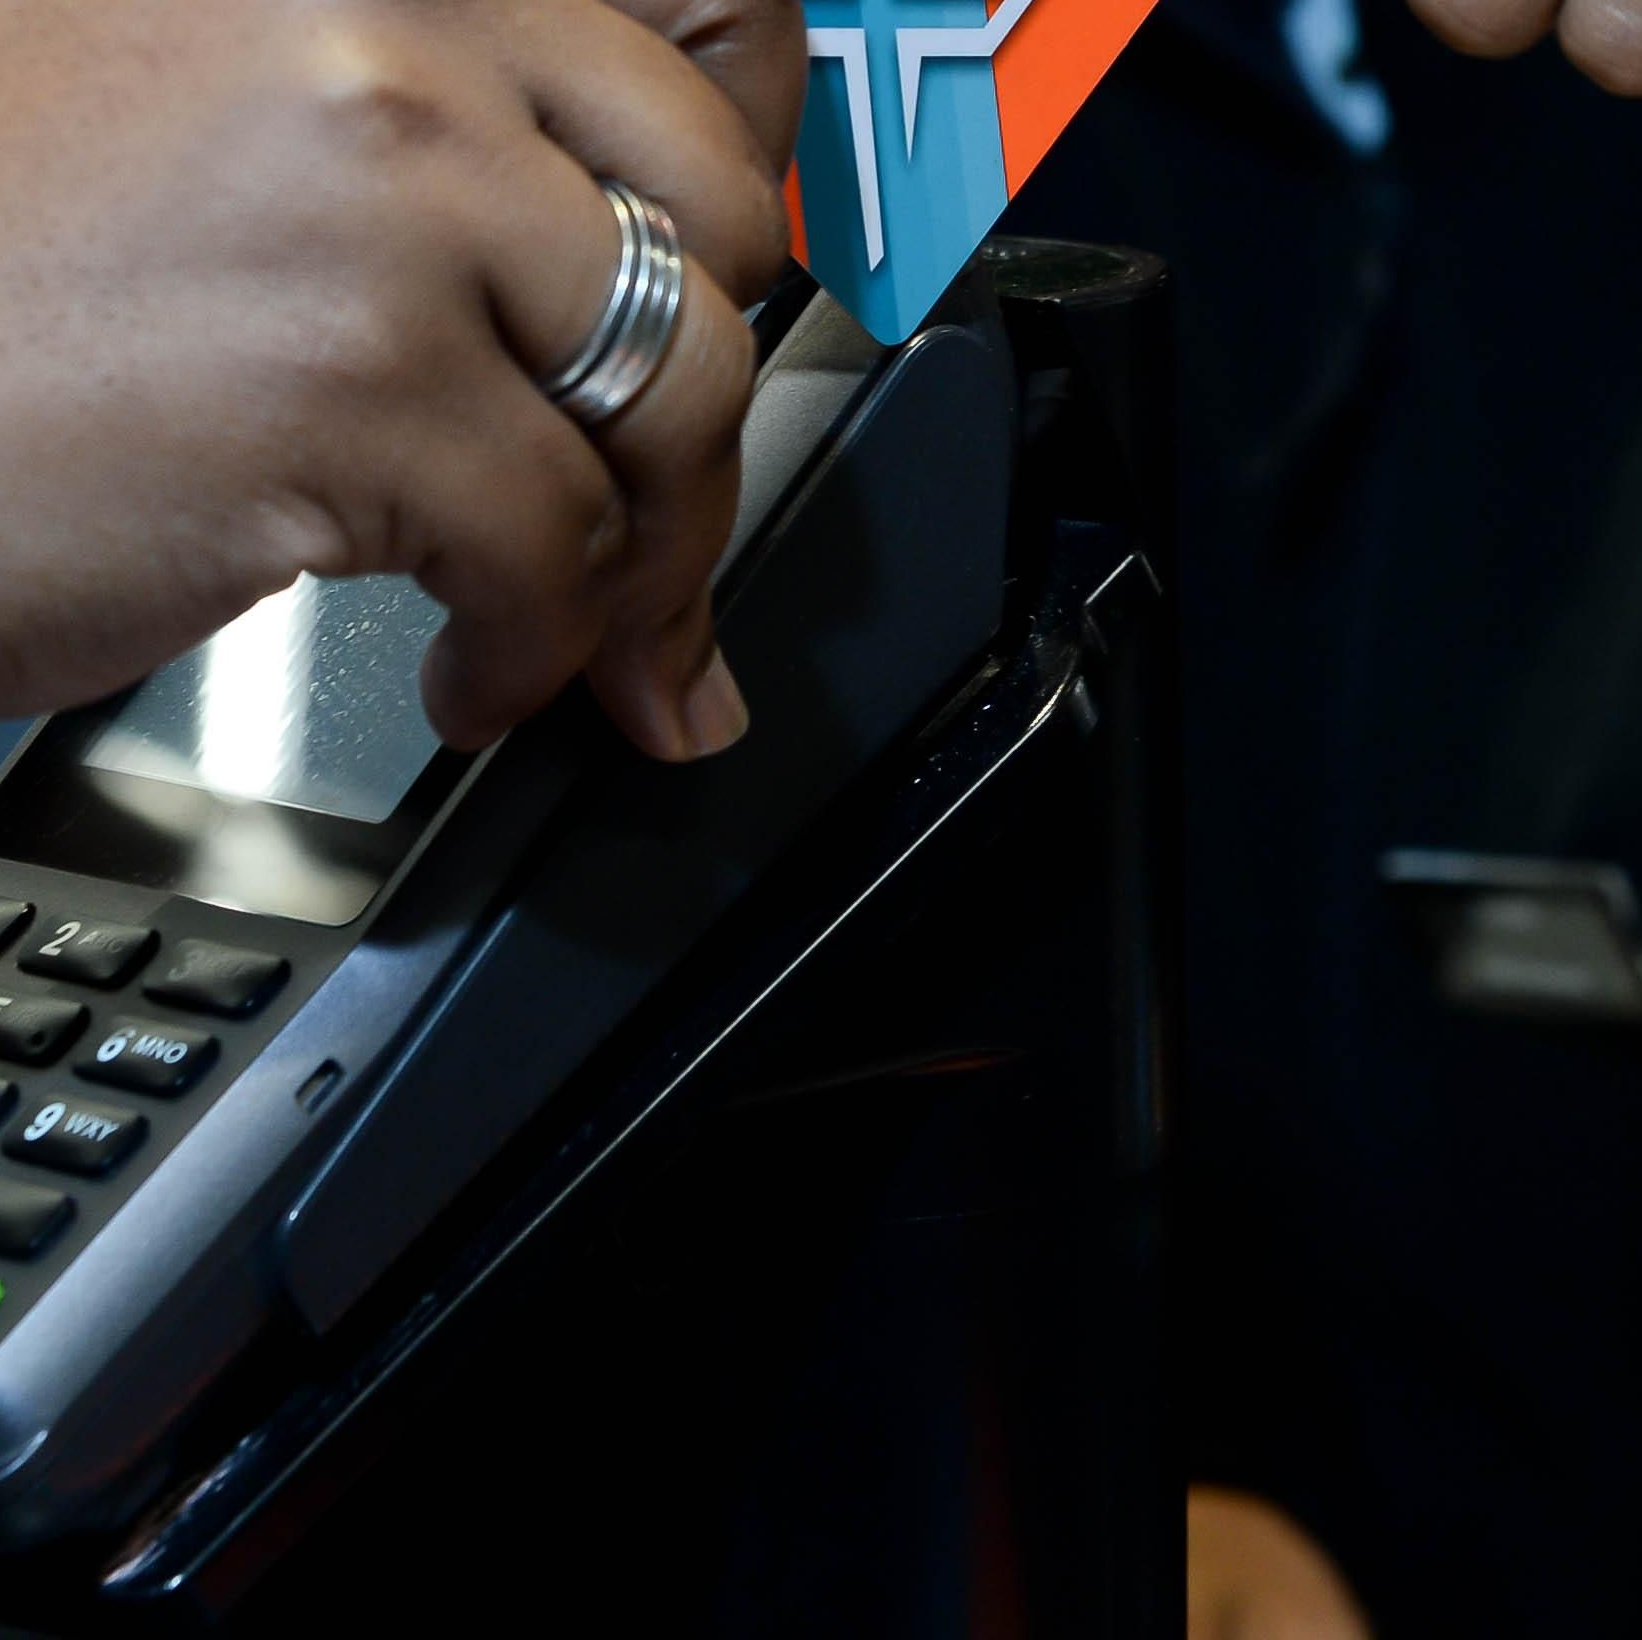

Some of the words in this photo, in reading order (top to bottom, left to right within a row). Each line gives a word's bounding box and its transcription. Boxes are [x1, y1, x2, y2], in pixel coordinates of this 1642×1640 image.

[38, 920, 82, 957] 2
[96, 1028, 137, 1063] 6
[131, 1034, 189, 1064] MNO
[23, 1101, 67, 1142] 9
[63, 1111, 121, 1143] WXY
